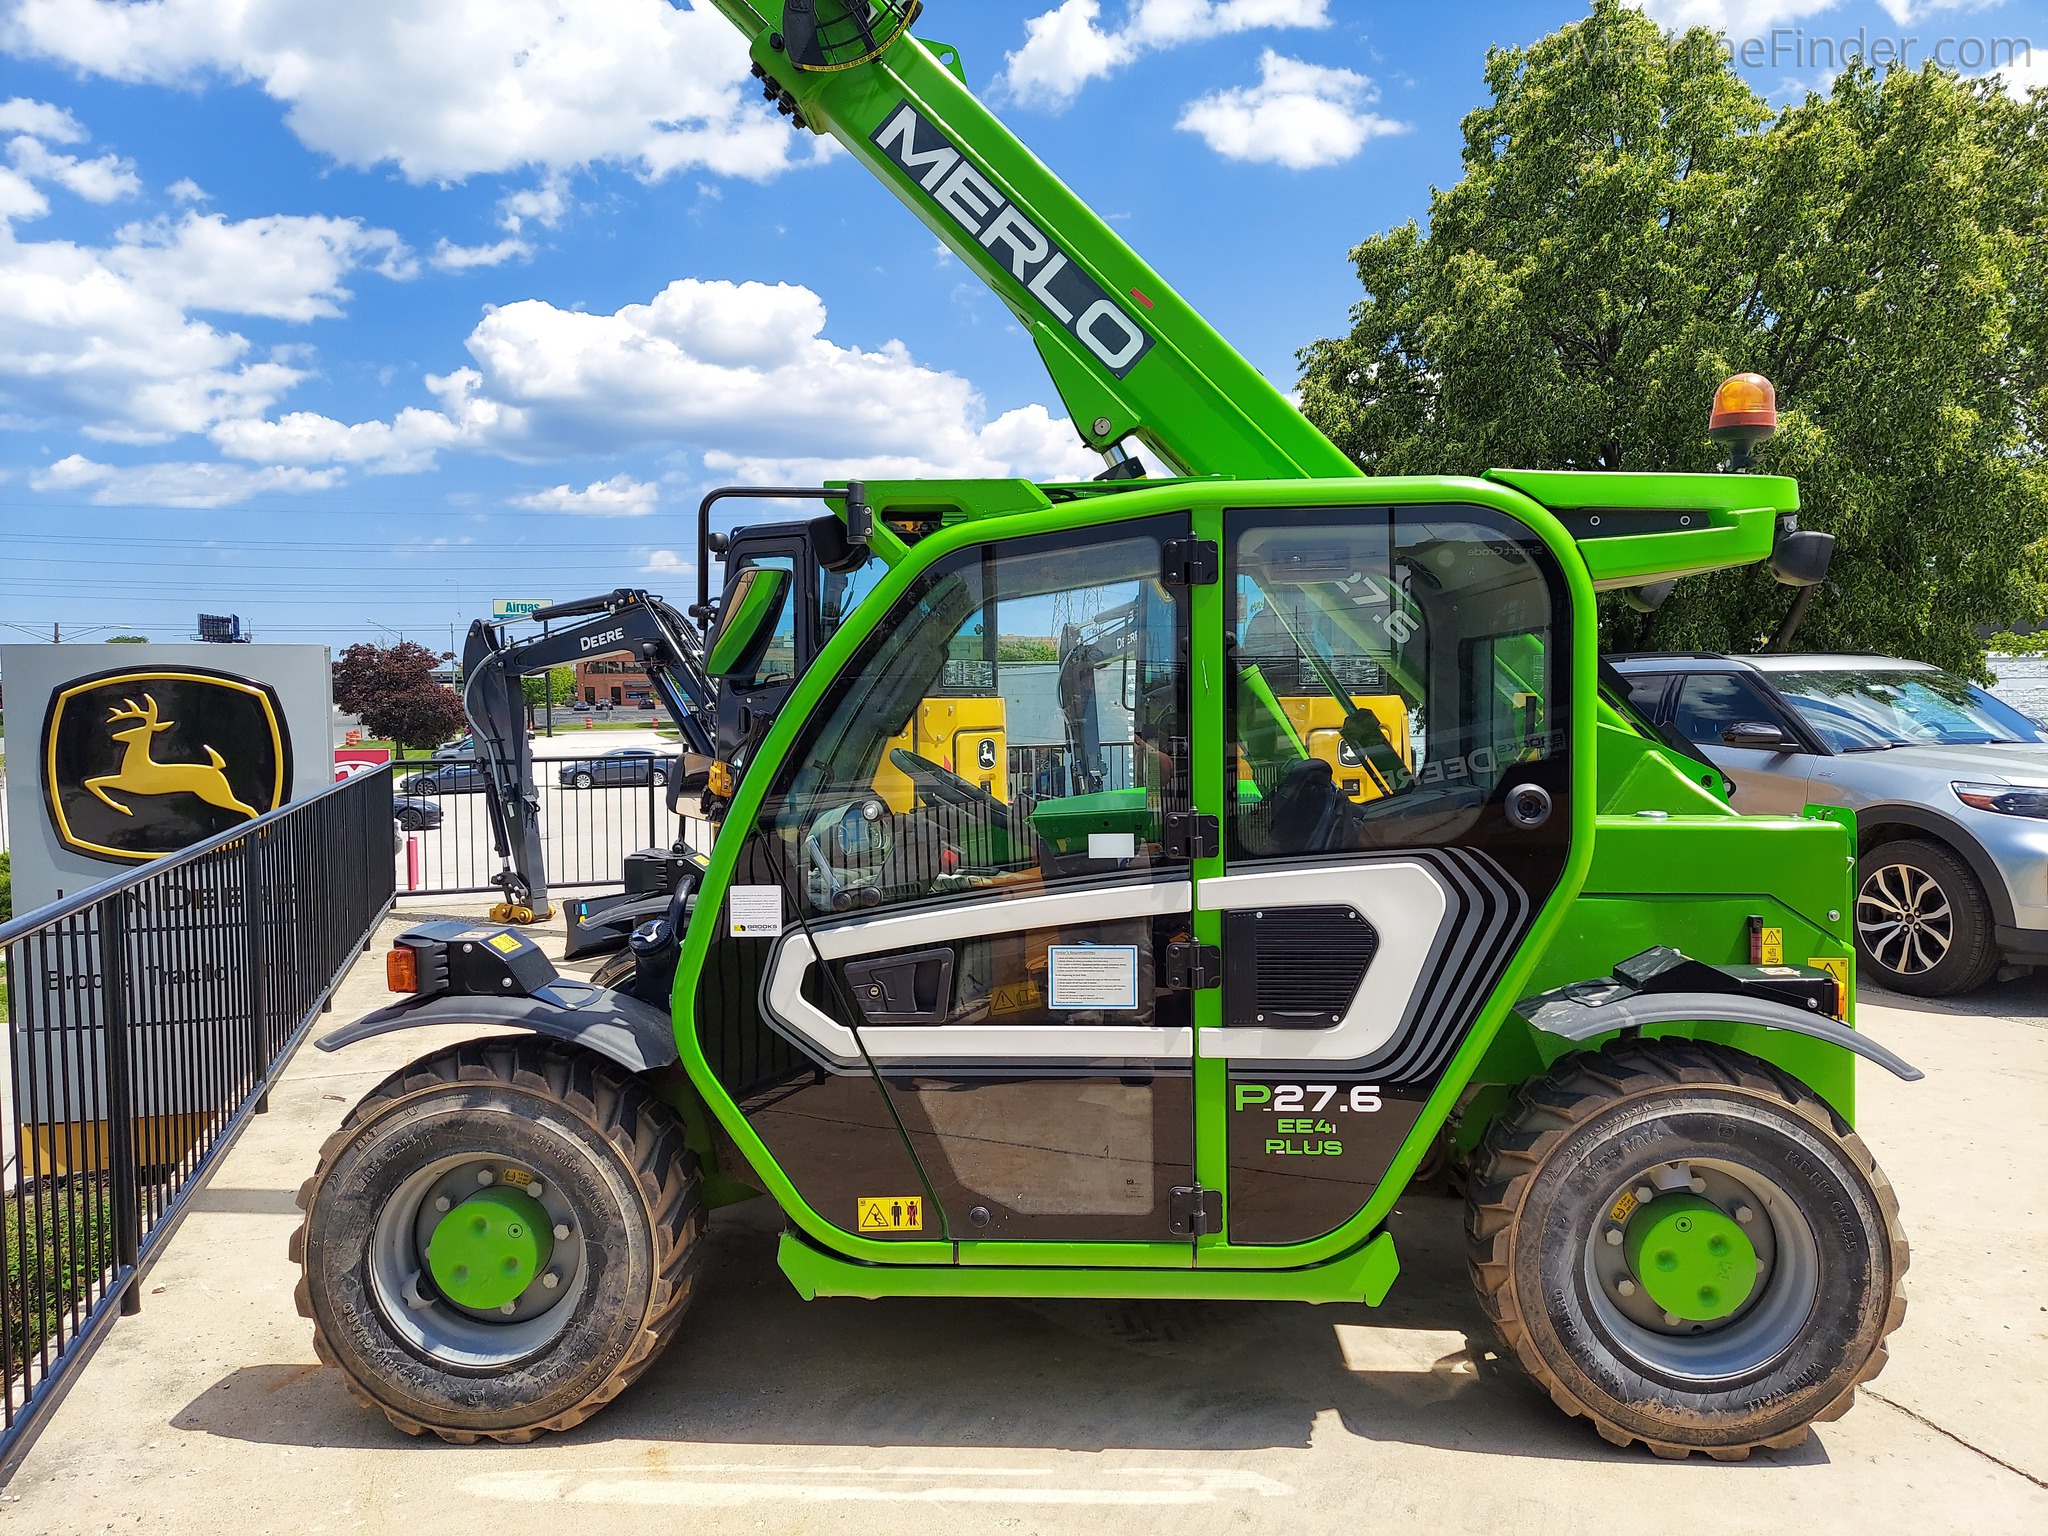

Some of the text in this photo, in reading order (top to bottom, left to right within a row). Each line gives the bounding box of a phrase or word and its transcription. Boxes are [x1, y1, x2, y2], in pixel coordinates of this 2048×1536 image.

[875, 104, 1145, 369] MERLO
[505, 602, 540, 613] Airgas
[580, 627, 624, 652] DEERE
[48, 970, 129, 990] Broo
[145, 963, 237, 986] Tracto
[1265, 1139, 1343, 1156] PLUS
